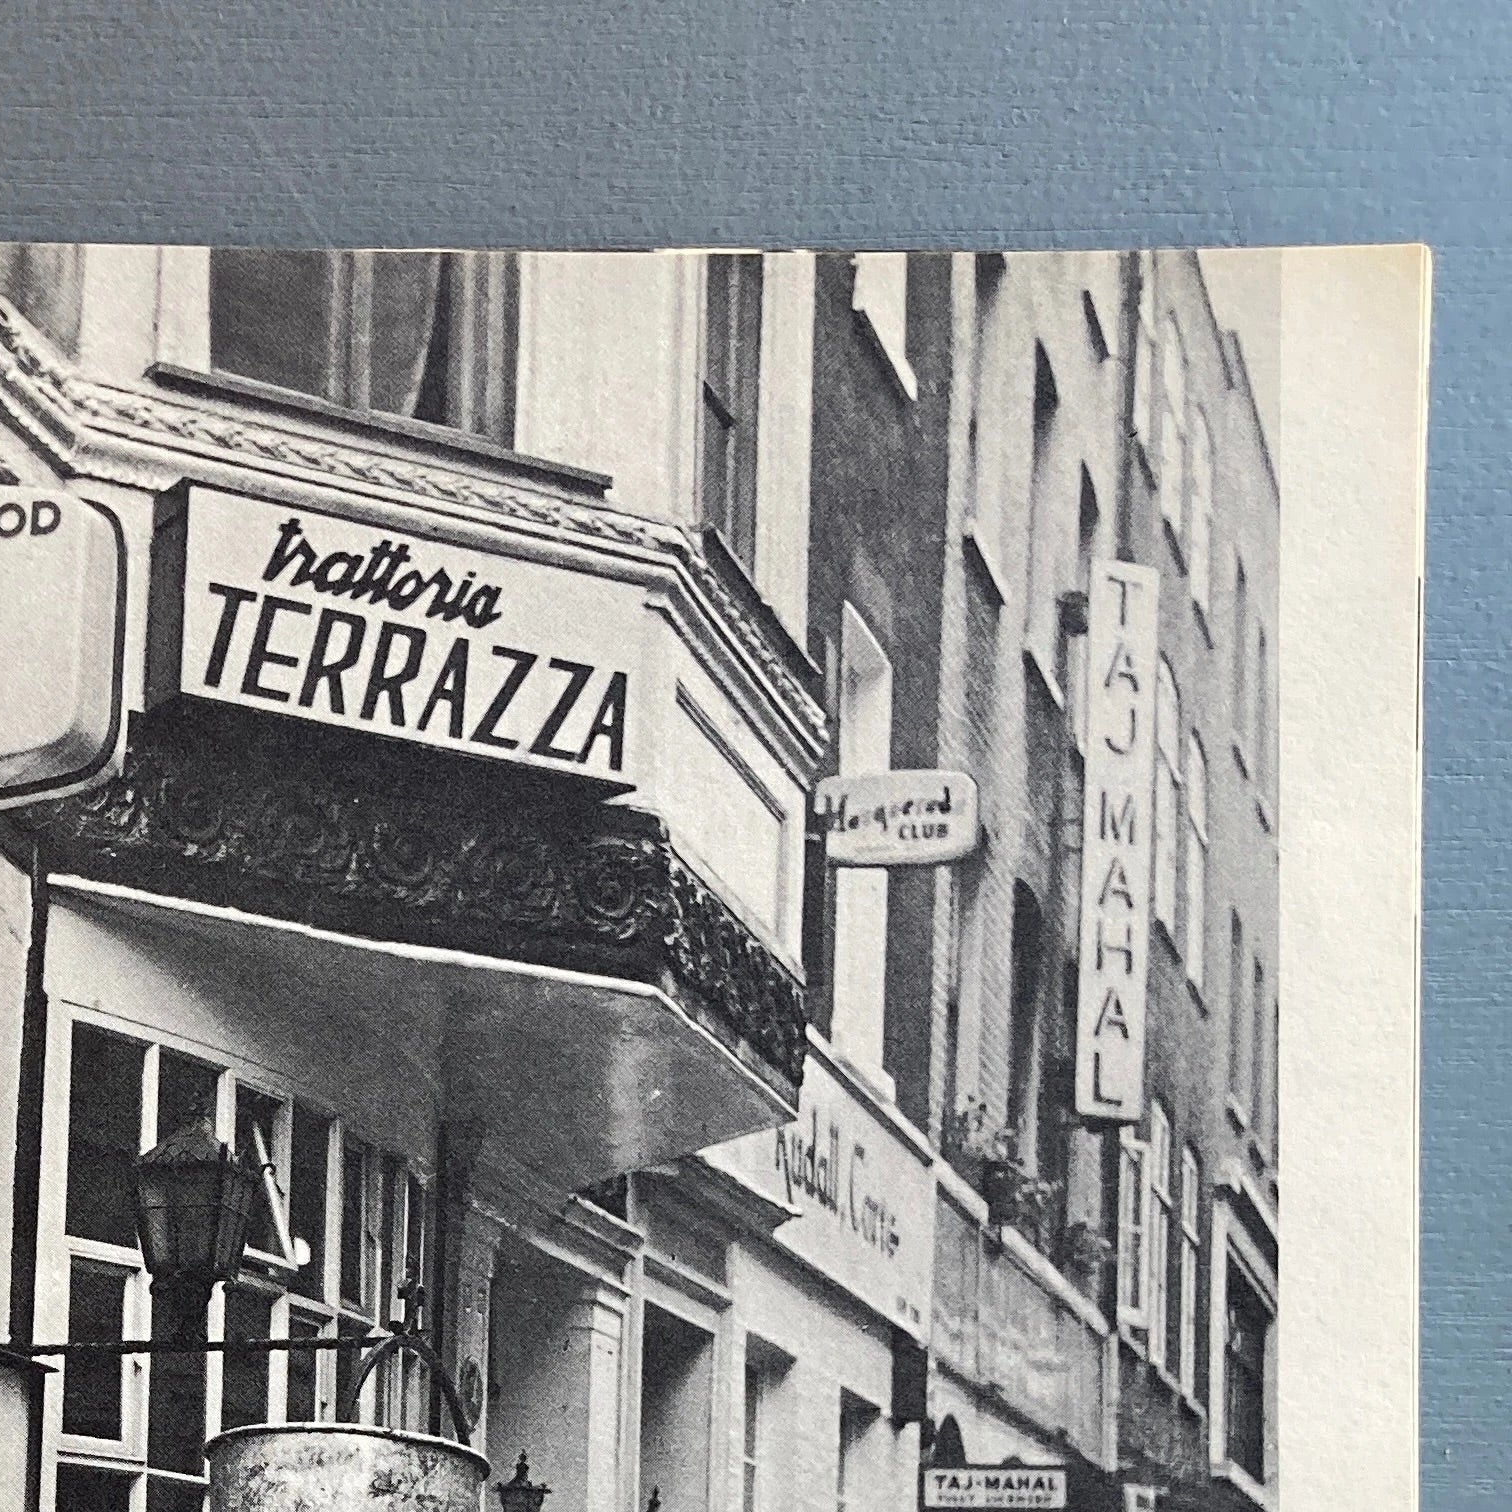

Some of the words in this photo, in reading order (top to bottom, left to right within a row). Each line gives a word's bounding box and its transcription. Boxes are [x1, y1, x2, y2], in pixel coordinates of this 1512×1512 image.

[204, 582, 627, 771] TERRAZZA
[1105, 576, 1142, 755] TAJ
[1093, 792, 1137, 1107] MAHAL
